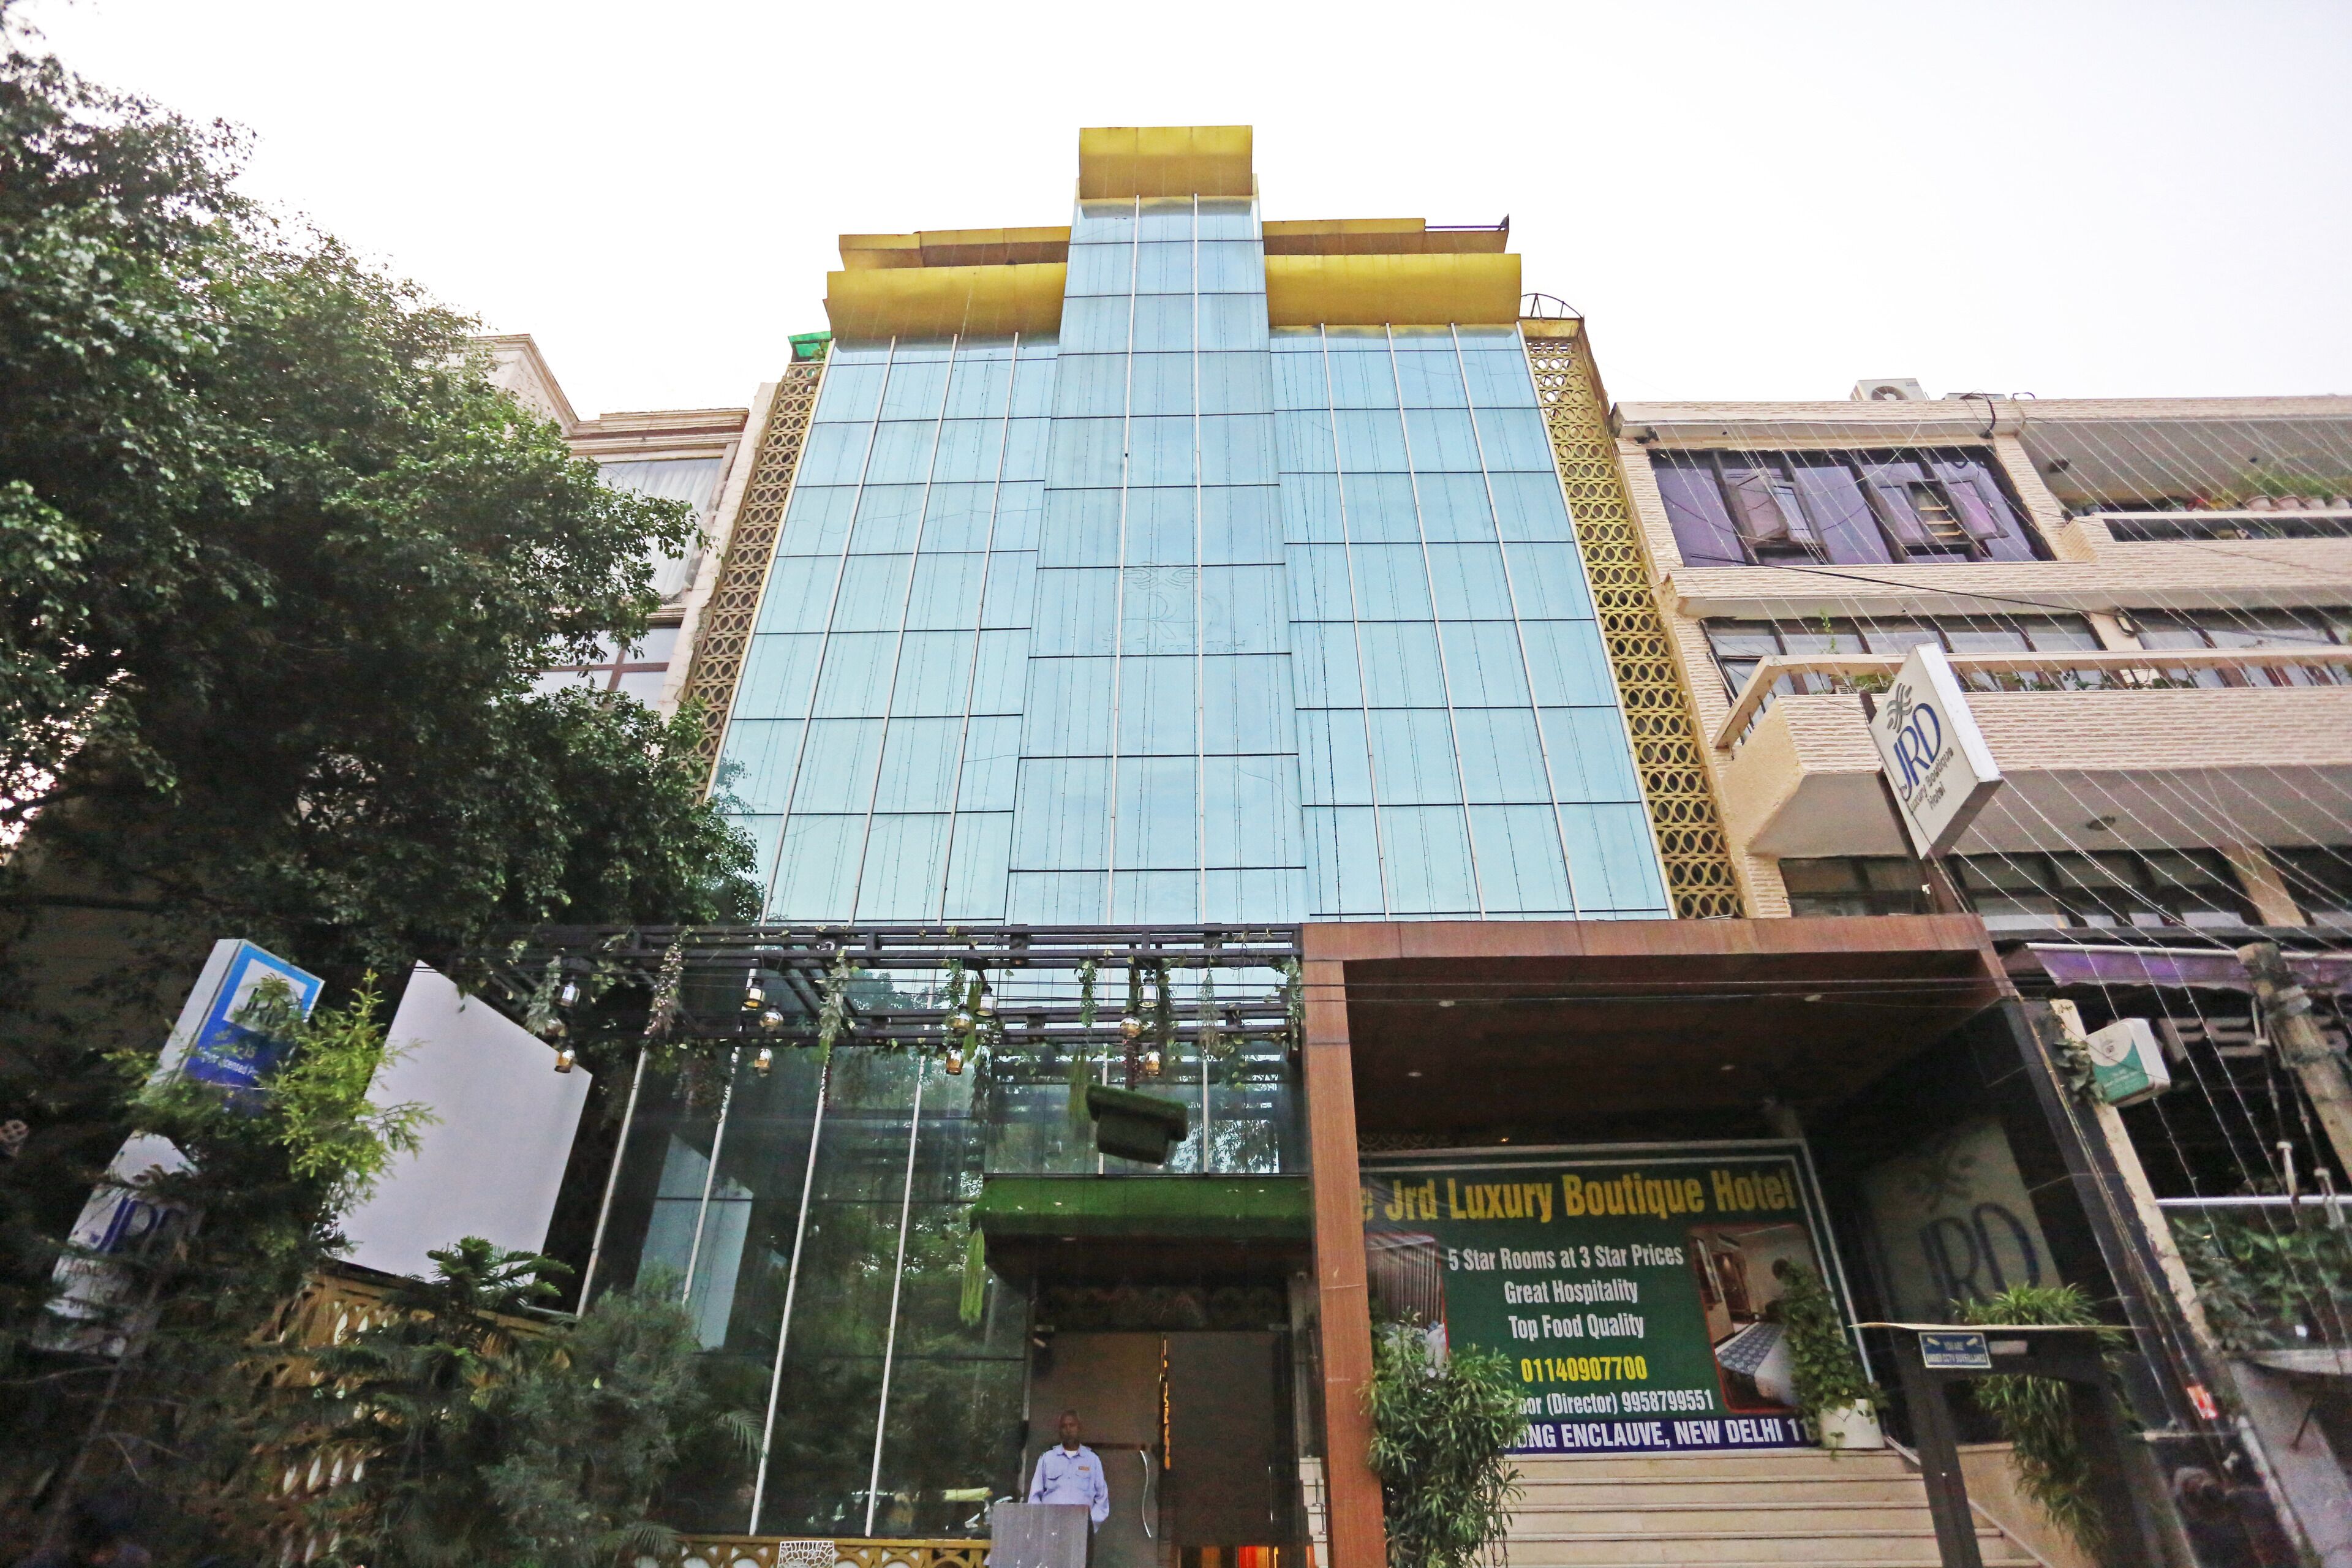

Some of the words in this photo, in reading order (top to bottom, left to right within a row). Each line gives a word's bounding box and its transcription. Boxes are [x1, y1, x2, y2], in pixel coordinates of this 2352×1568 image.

[1893, 703, 1941, 801] JRD
[1925, 747, 1954, 788] Boutique
[1927, 782, 1946, 811] Hotel
[1385, 1178, 1438, 1221] Jrd
[1447, 1177, 1553, 1223] Luxury
[1562, 1172, 1705, 1219] Boutique
[1711, 1167, 1797, 1212] Hotel
[1448, 1248, 1459, 1271] 5
[1463, 1247, 1496, 1271] Star
[1499, 1247, 1555, 1270] Rooms
[1560, 1246, 1577, 1268] at
[1579, 1245, 1591, 1268] 3
[1594, 1245, 1627, 1267] Star
[1631, 1243, 1684, 1266] Prices
[1504, 1281, 1550, 1304] Great
[1552, 1278, 1638, 1305] Hospitality
[1509, 1315, 1539, 1341] Top
[1542, 1314, 1584, 1338] Food
[1586, 1312, 1644, 1340] Quality
[1521, 1355, 1648, 1382] 01140907700
[1547, 1392, 1618, 1416] (Director)
[1621, 1389, 1714, 1413] 9958799551
[1561, 1421, 1671, 1449] ENCLAUVE,
[1674, 1420, 1721, 1446] NEW
[1725, 1418, 1784, 1443] DELHI
